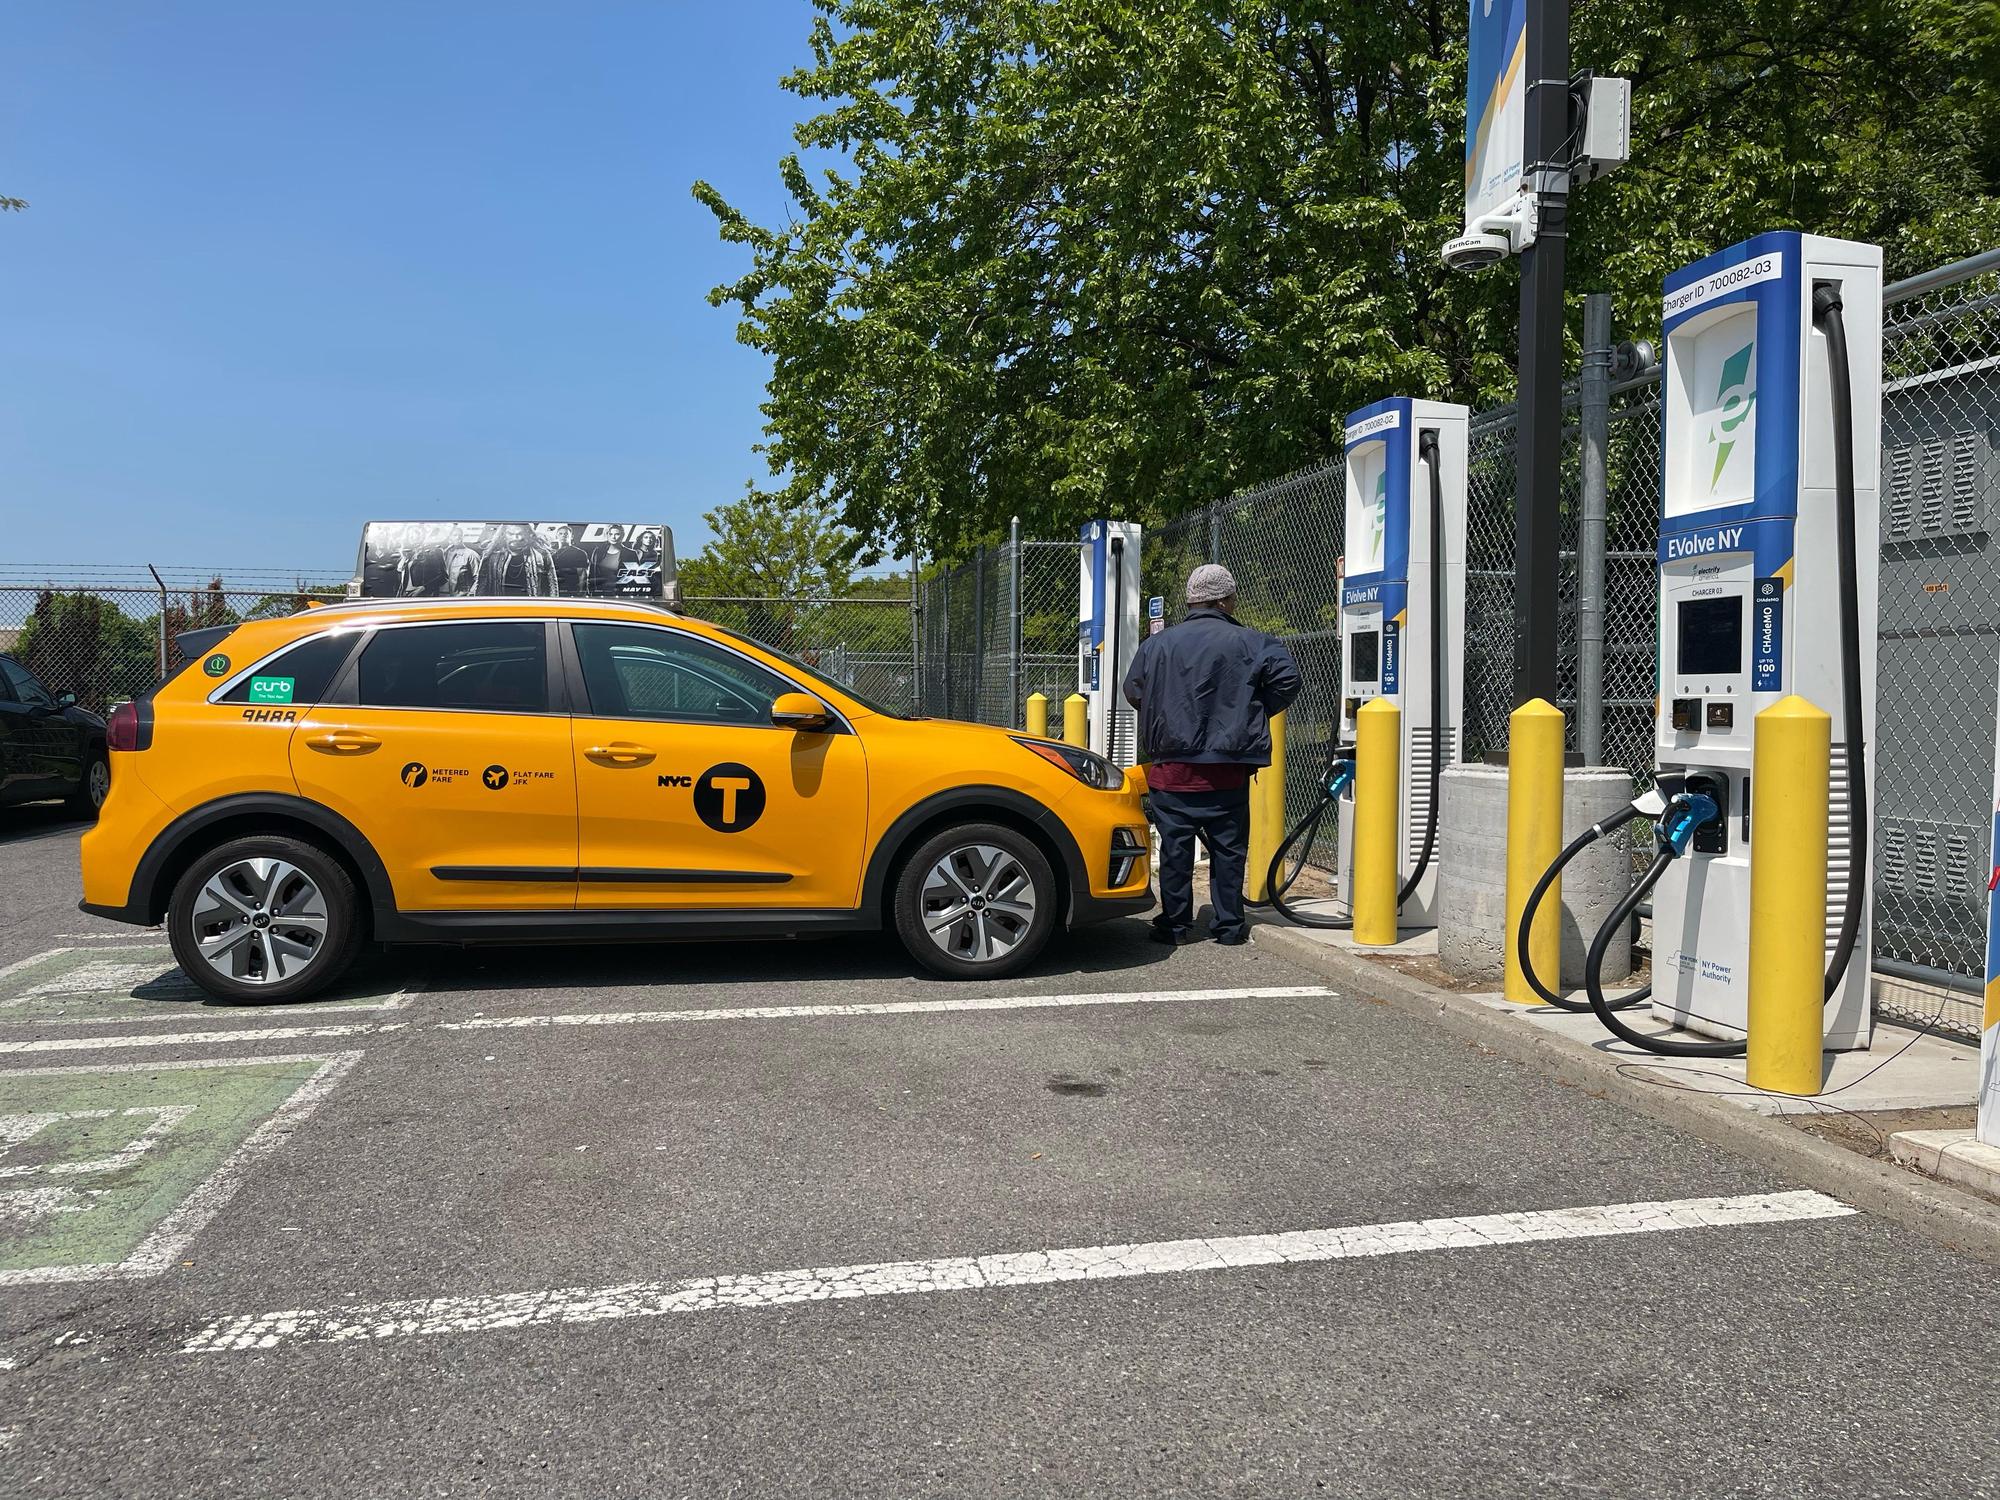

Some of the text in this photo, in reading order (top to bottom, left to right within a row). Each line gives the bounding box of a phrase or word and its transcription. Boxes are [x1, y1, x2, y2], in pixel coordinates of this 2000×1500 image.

[1449, 240, 1481, 250] EarthCam
[1694, 285, 1704, 298] ID
[1709, 260, 1772, 292] 700082-03
[1668, 527, 1743, 558] EVolve NY
[616, 568, 660, 577] FAST
[1346, 587, 1379, 604] EVolve NY
[1762, 607, 1773, 654] CHAdeMO
[1758, 664, 1775, 672] 100
[254, 681, 291, 692] curb
[432, 768, 469, 776] METERED
[657, 775, 750, 824] NYC T
[1702, 961, 1710, 969] NY
[1711, 963, 1731, 973] Power
[1702, 970, 1732, 985] Authority
